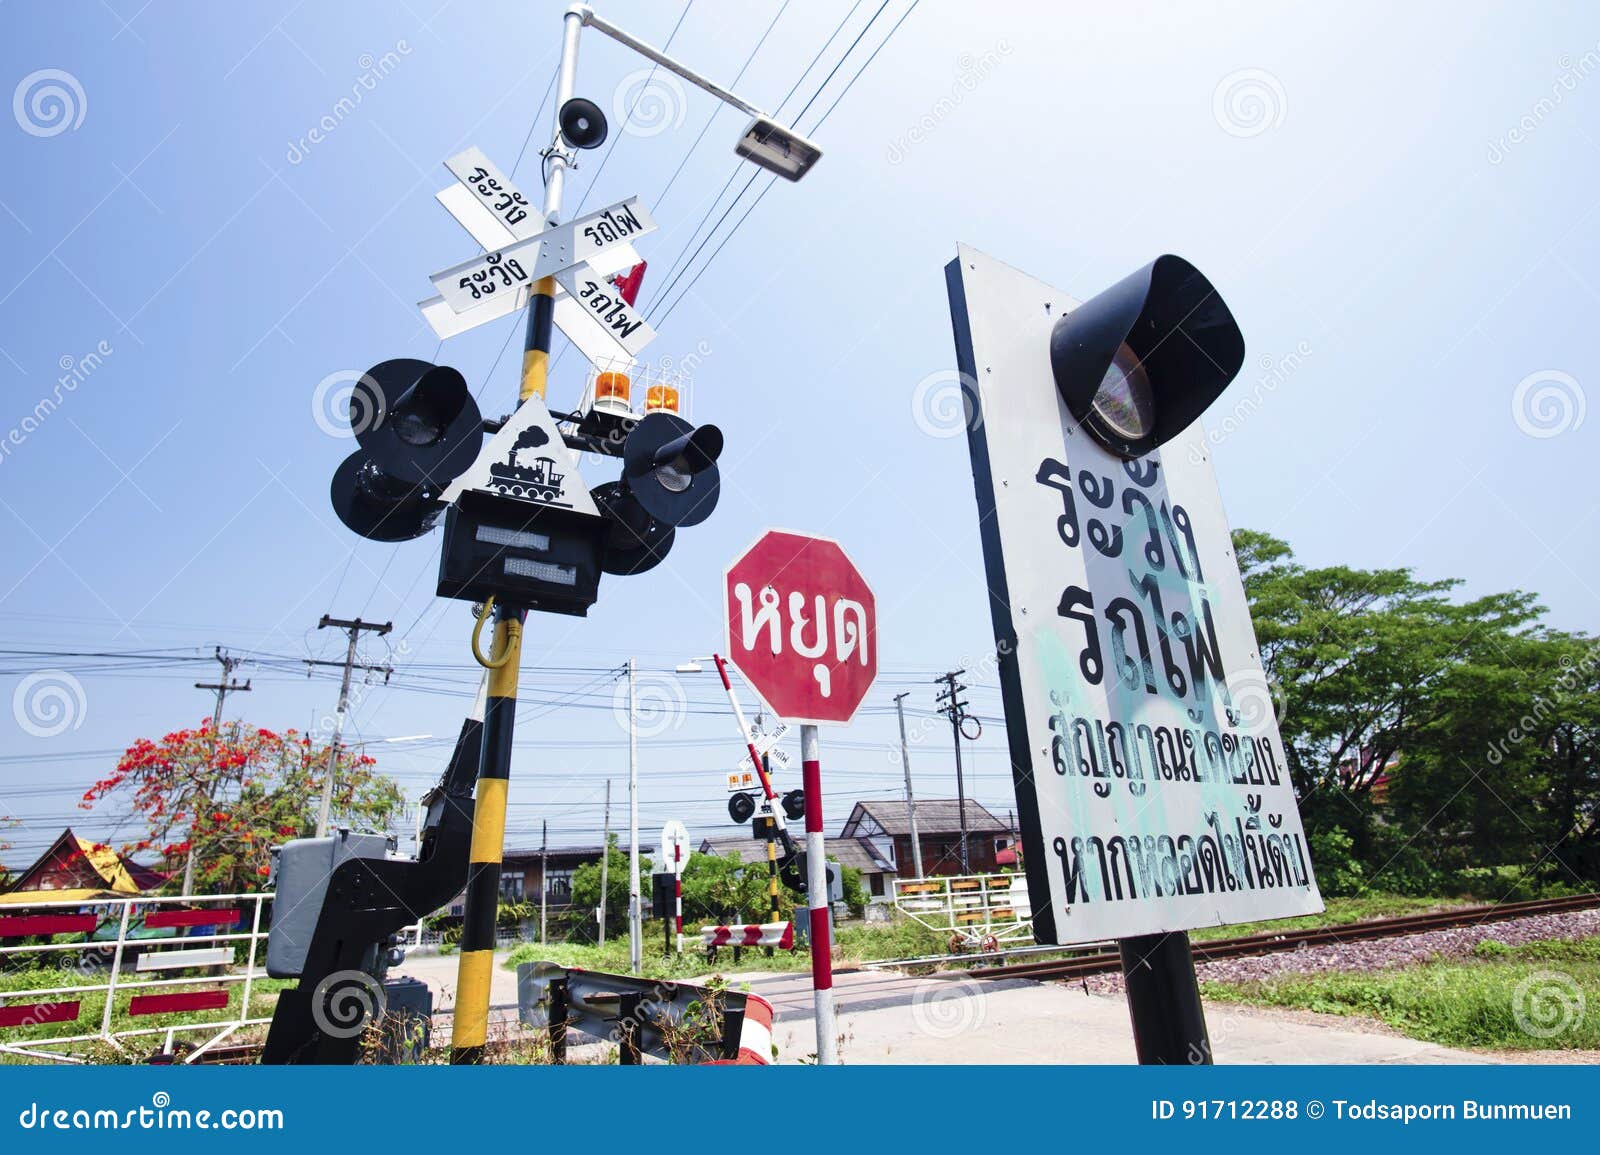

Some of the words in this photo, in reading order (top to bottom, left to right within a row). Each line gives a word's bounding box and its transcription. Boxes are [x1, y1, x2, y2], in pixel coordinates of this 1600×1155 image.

[459, 252, 528, 300] ระวัง
[583, 203, 643, 247] รถไฟ
[467, 167, 528, 226] ระวัง
[579, 280, 643, 339] รถไฟ
[1036, 457, 1204, 584] ระวัง
[734, 582, 868, 698] หยุด
[1057, 568, 1232, 707] รถไฟ
